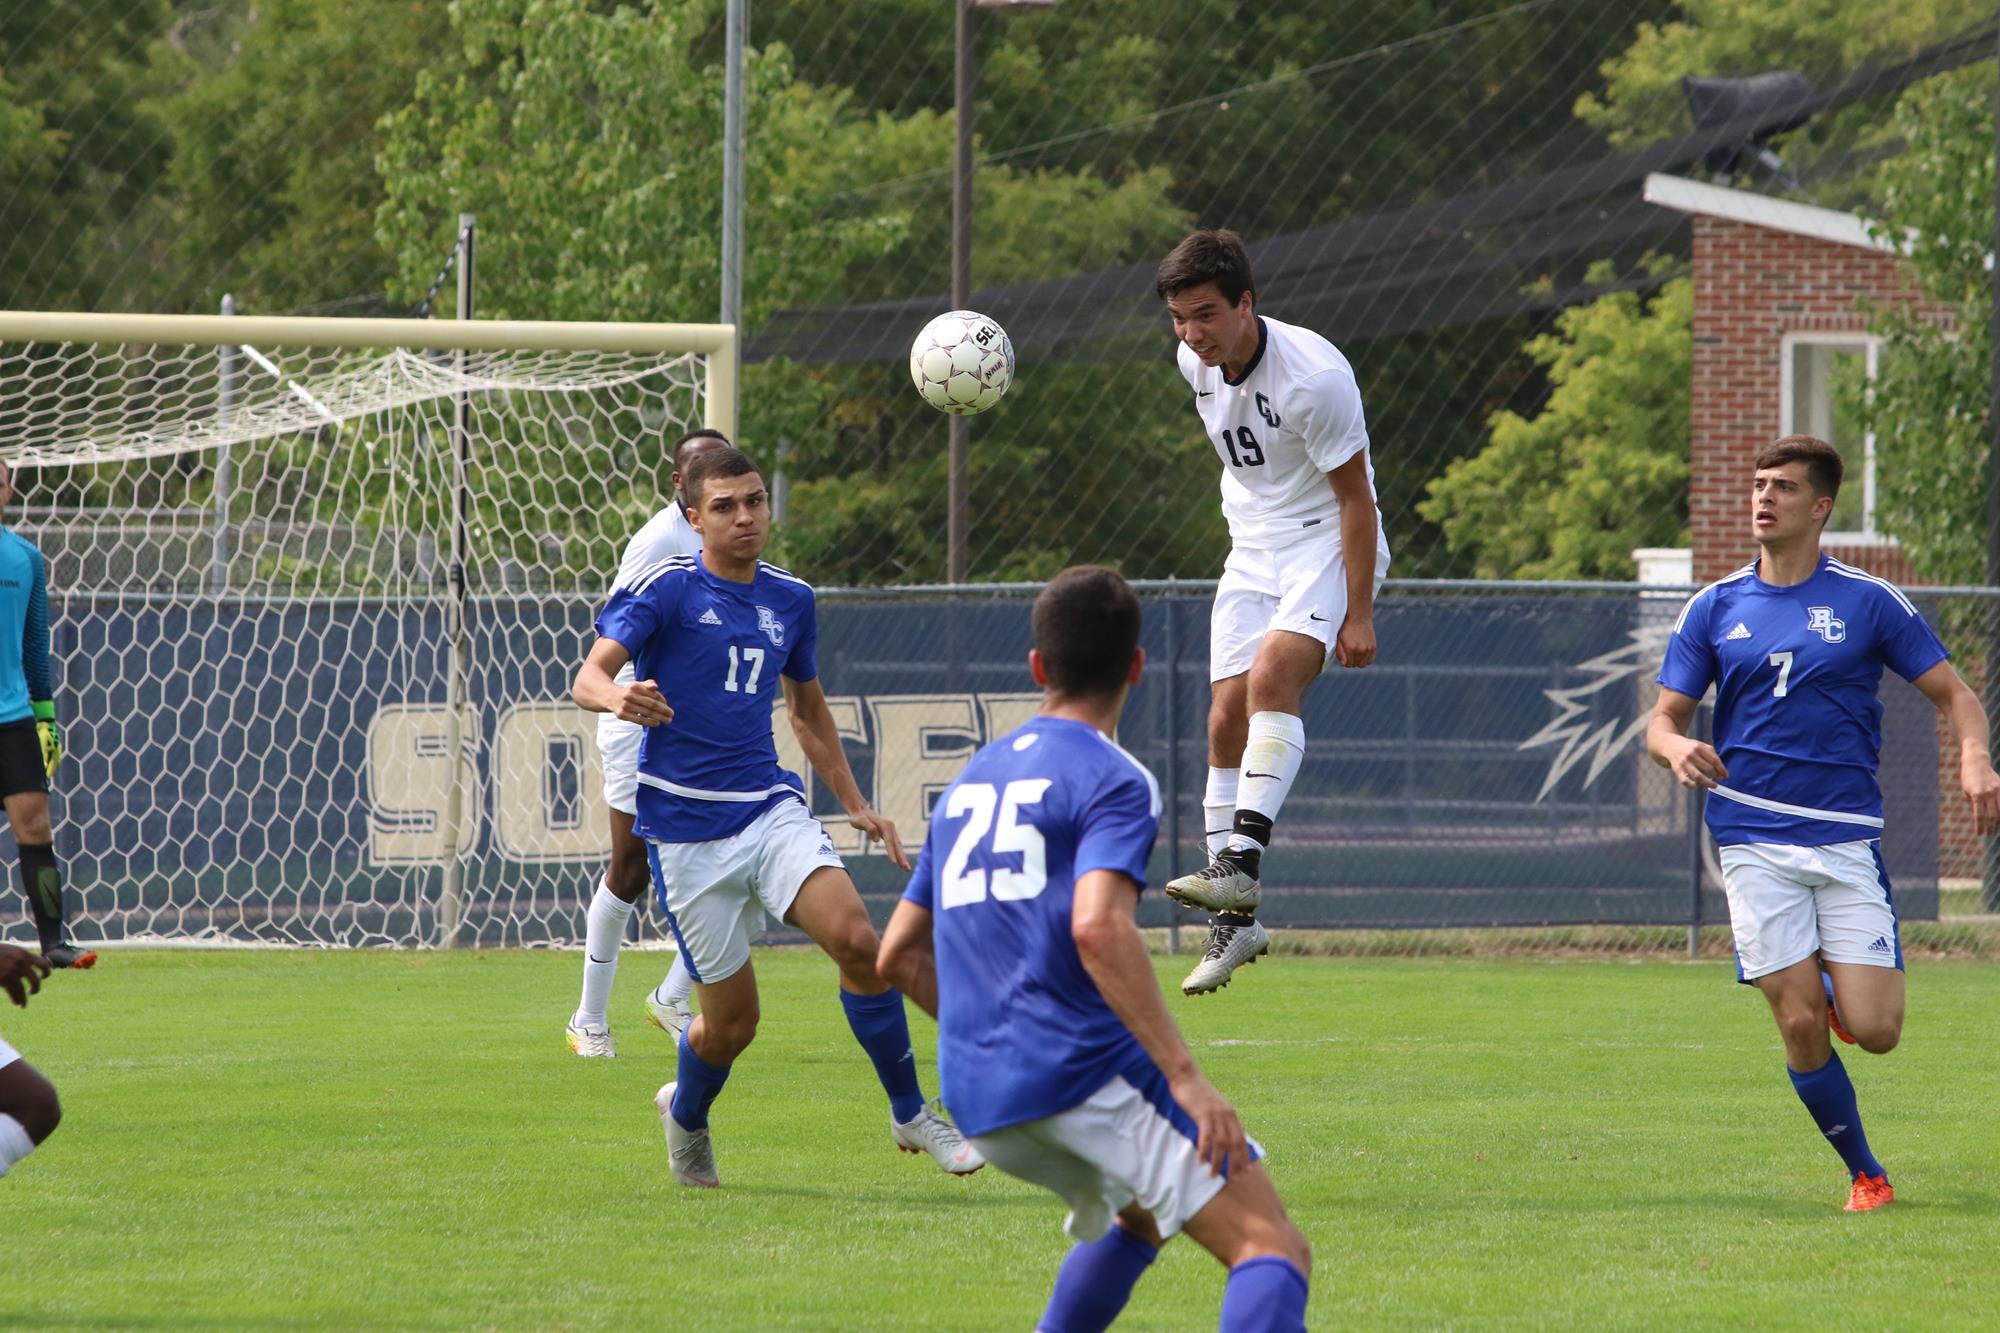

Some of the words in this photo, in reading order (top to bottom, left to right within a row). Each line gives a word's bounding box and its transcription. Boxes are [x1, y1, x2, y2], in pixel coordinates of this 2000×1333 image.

[1222, 426, 1265, 468] 19
[755, 605, 785, 646] BC
[1808, 606, 1846, 643] BC
[724, 645, 765, 694] 17
[1769, 651, 1794, 697] 7
[941, 778, 1053, 910] 25
